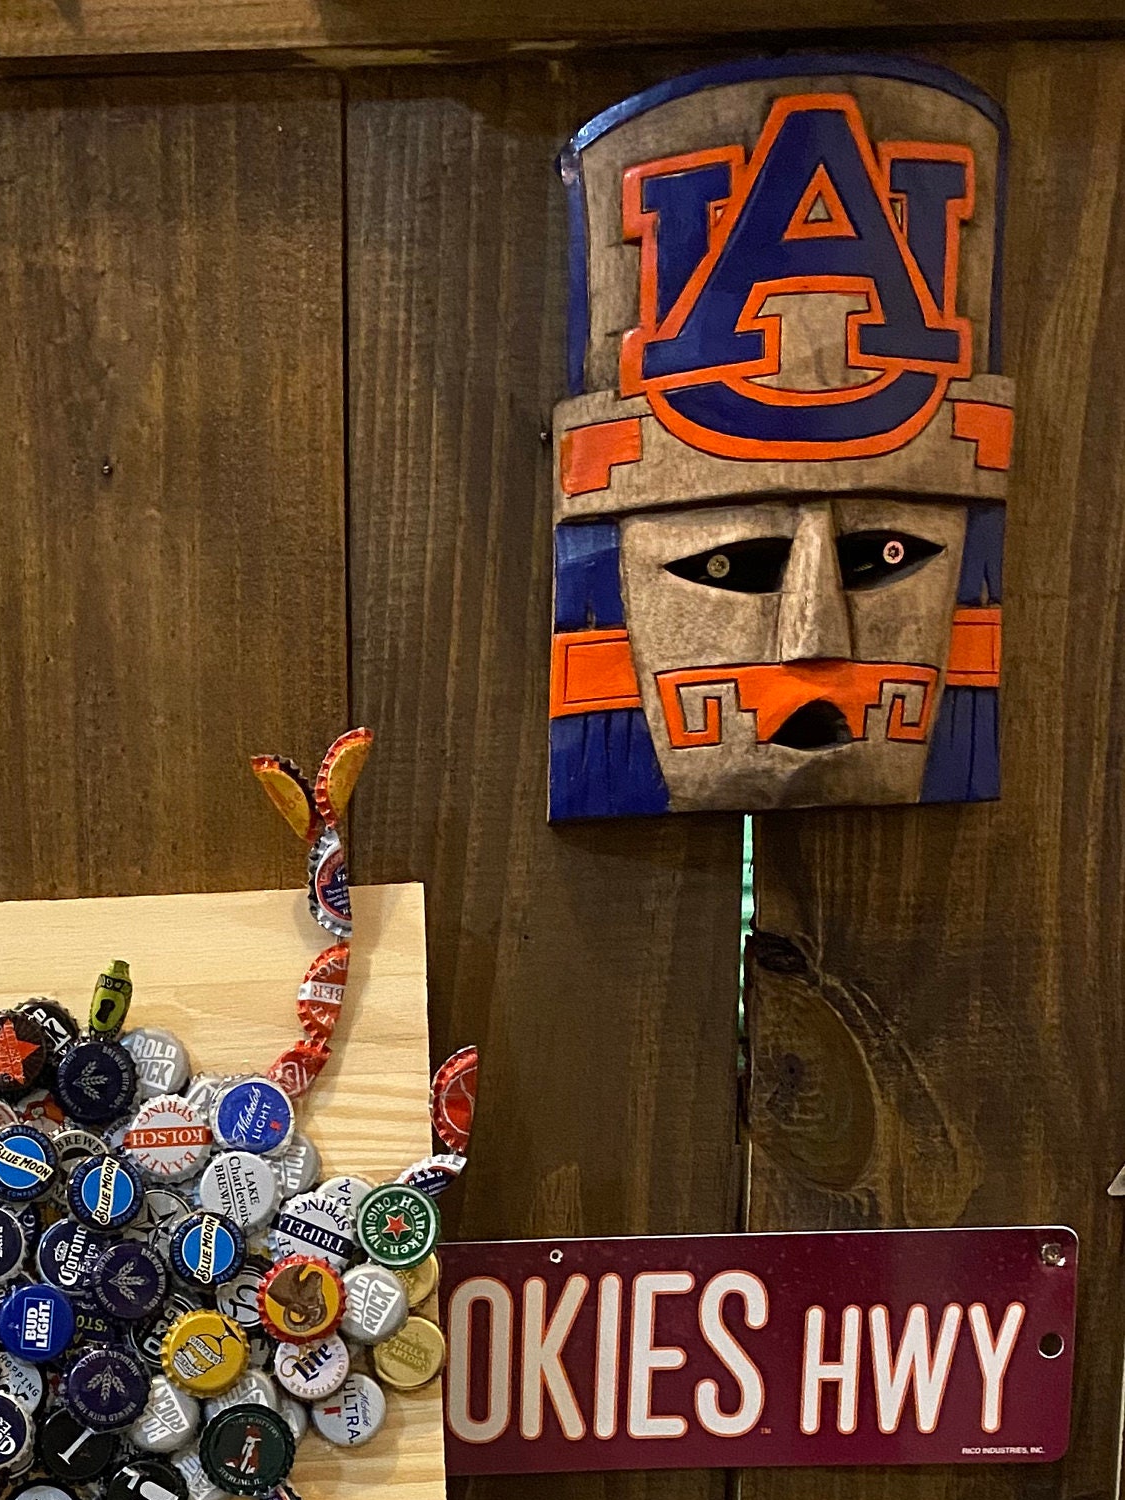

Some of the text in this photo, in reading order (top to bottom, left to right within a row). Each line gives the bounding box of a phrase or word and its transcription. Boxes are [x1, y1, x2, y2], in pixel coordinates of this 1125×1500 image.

[137, 1059, 174, 1090] OCK
[137, 1101, 194, 1126] SPRING
[251, 1102, 272, 1140] LIGHT
[56, 1133, 104, 1155] BREWE
[22, 1158, 52, 1179] MOON
[95, 1159, 117, 1224] BLUE MOON
[228, 1156, 249, 1225] Charlevoix
[244, 1171, 261, 1205] LAKE
[295, 1199, 351, 1232] SPRING
[365, 1195, 427, 1256] ORIGINAL Heineken
[195, 1217, 218, 1283] BLUE MOON
[280, 1217, 345, 1254] TRIPEL
[24, 1307, 38, 1341] BUD
[365, 1282, 397, 1335] ROCK
[293, 1344, 334, 1384] Lite
[446, 1270, 1025, 1443] OKIES HWY
[344, 1379, 361, 1442] ULTRA
